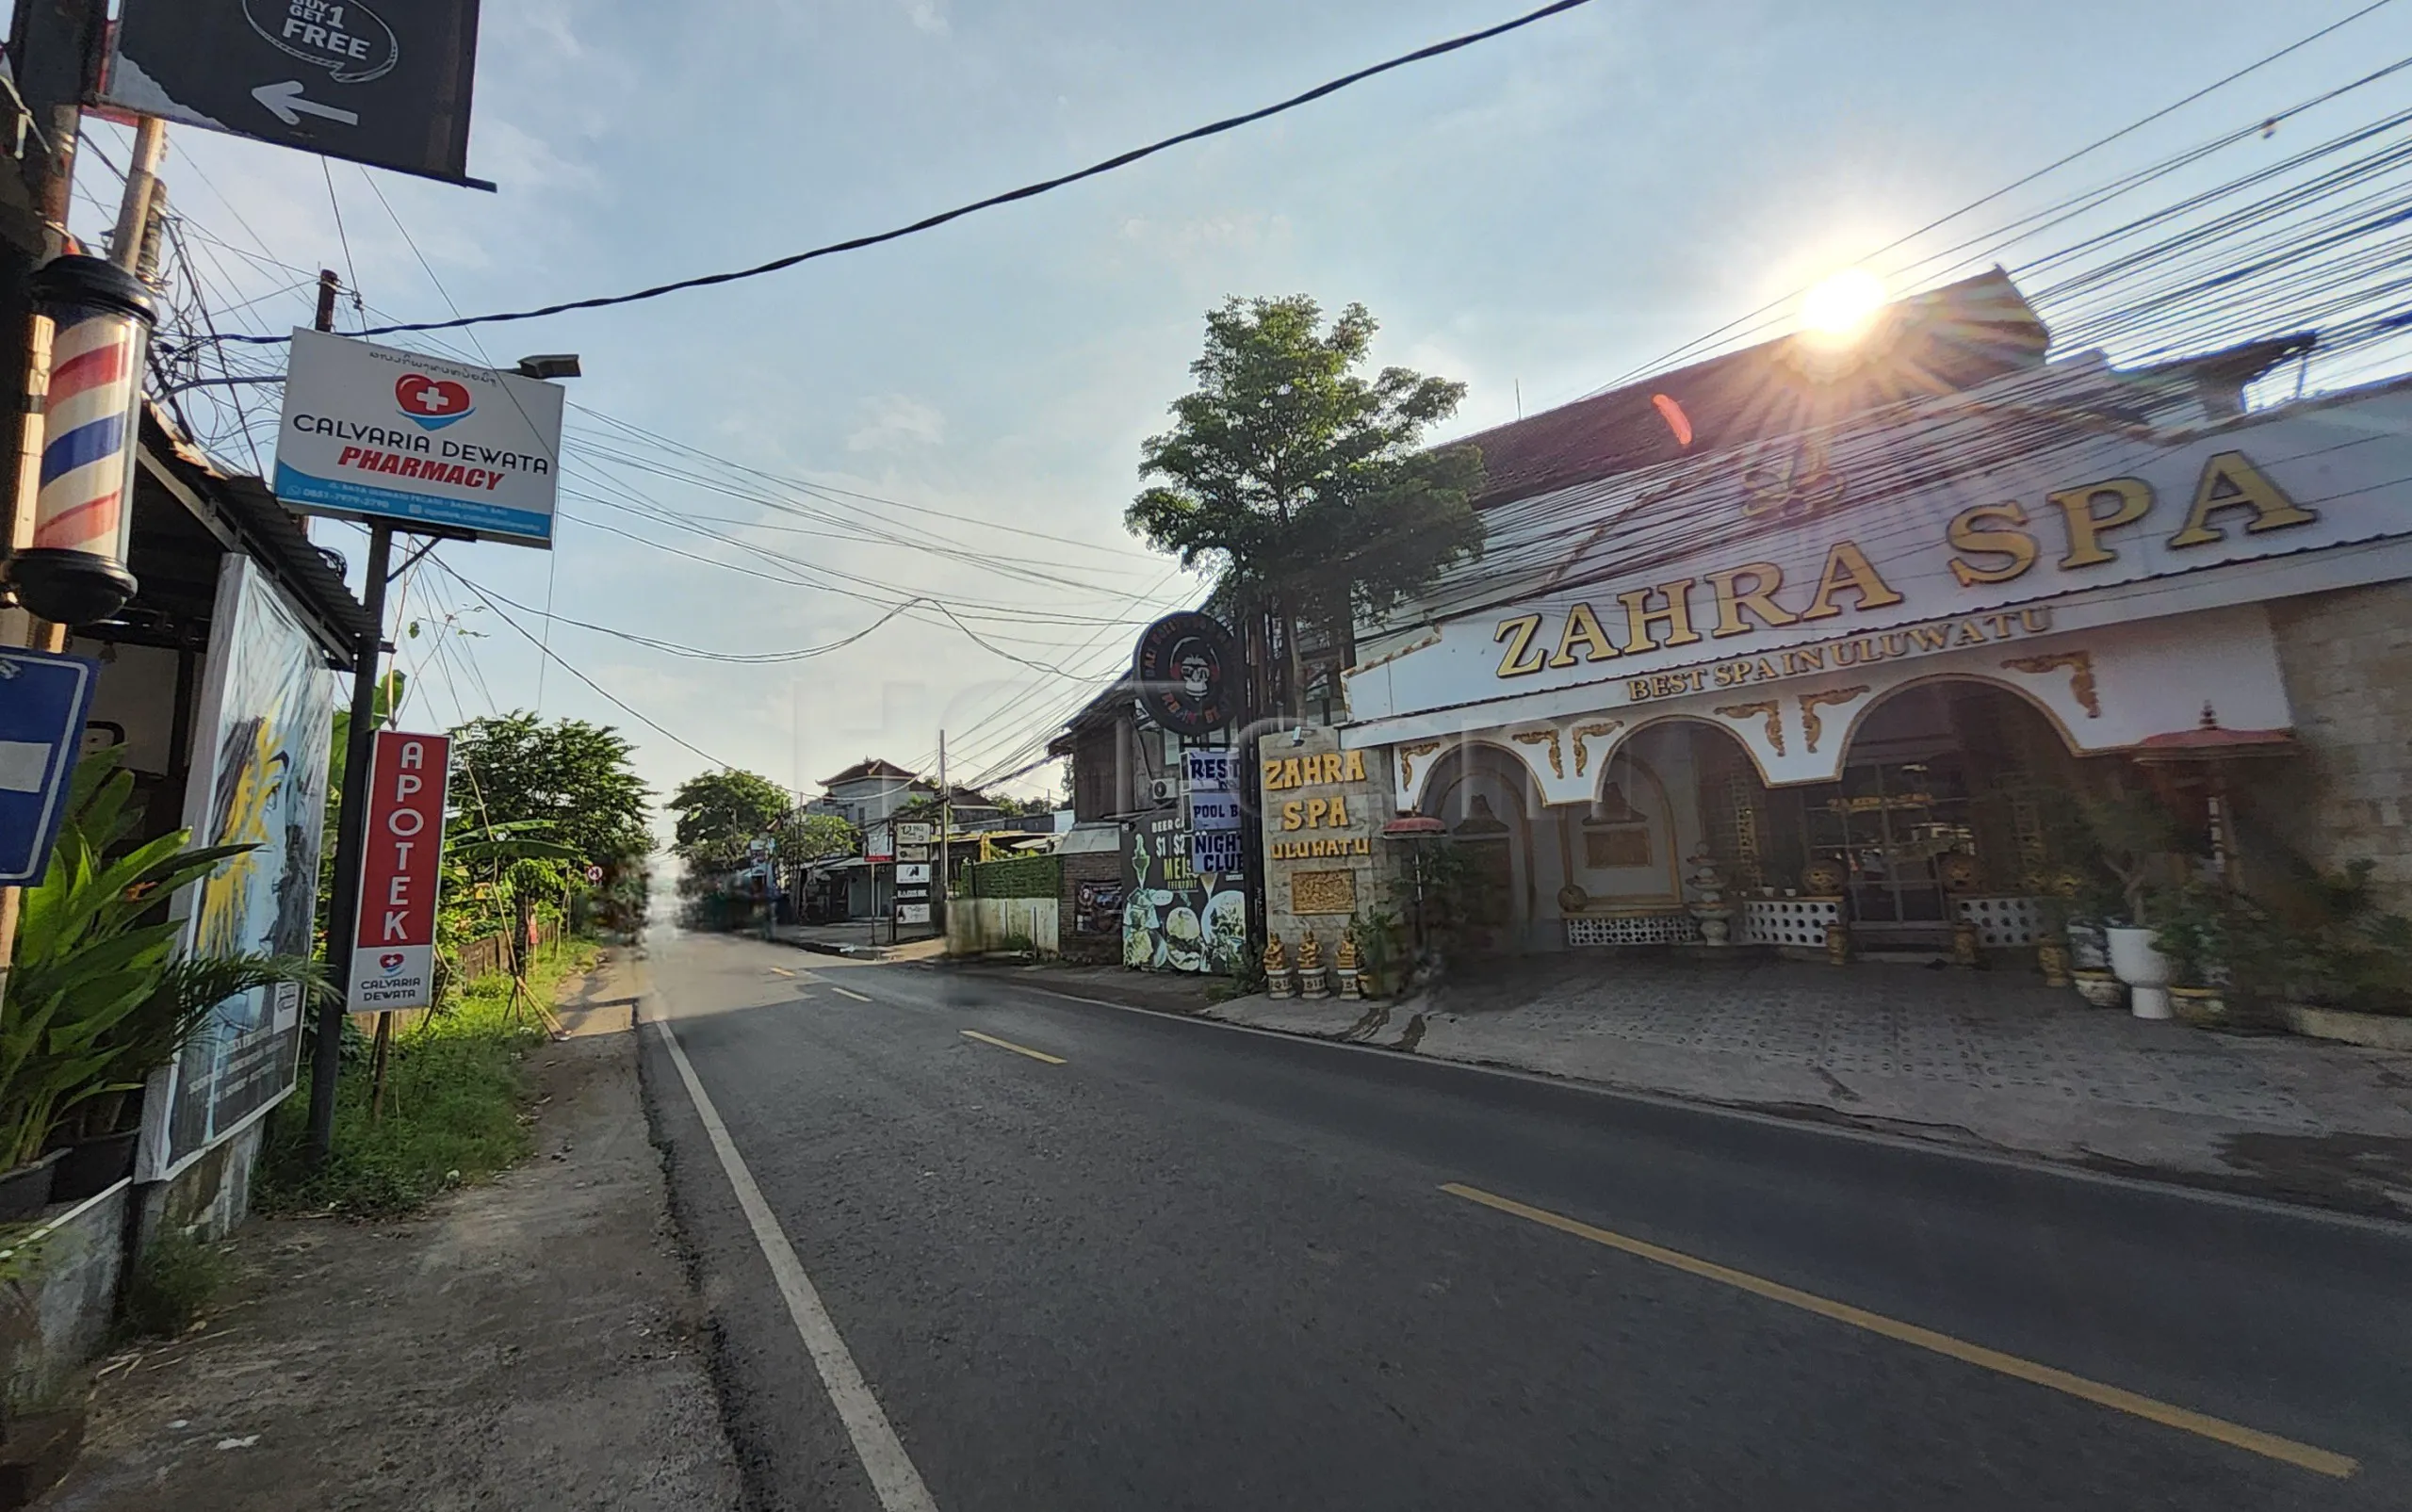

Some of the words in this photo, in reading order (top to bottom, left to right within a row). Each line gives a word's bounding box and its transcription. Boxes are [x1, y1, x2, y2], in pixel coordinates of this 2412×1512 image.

[289, 5, 325, 24] GET
[326, 6, 344, 29] 1
[283, 18, 371, 60] FREE
[293, 415, 430, 453] CALVARIA
[442, 441, 548, 475] DEWATA
[337, 446, 506, 491] PHARMACY
[1492, 541, 1903, 680] ZAHRA
[1947, 448, 2319, 589] SPA
[1628, 668, 1709, 702] BEST
[1713, 659, 1776, 687] SPA
[1781, 647, 1825, 675] IN
[1827, 606, 2054, 666] ULUWATU
[1264, 750, 1366, 790] ZAHRA
[1151, 819, 1173, 833] BEER
[1193, 805, 1225, 819] POOL
[1230, 804, 1241, 818] B
[1282, 796, 1349, 831] SPA
[383, 740, 425, 940] APOTEK
[1270, 837, 1371, 860] ULUWATU
[361, 977, 420, 990] CALVARIA
[364, 989, 416, 1001] DEWATA
